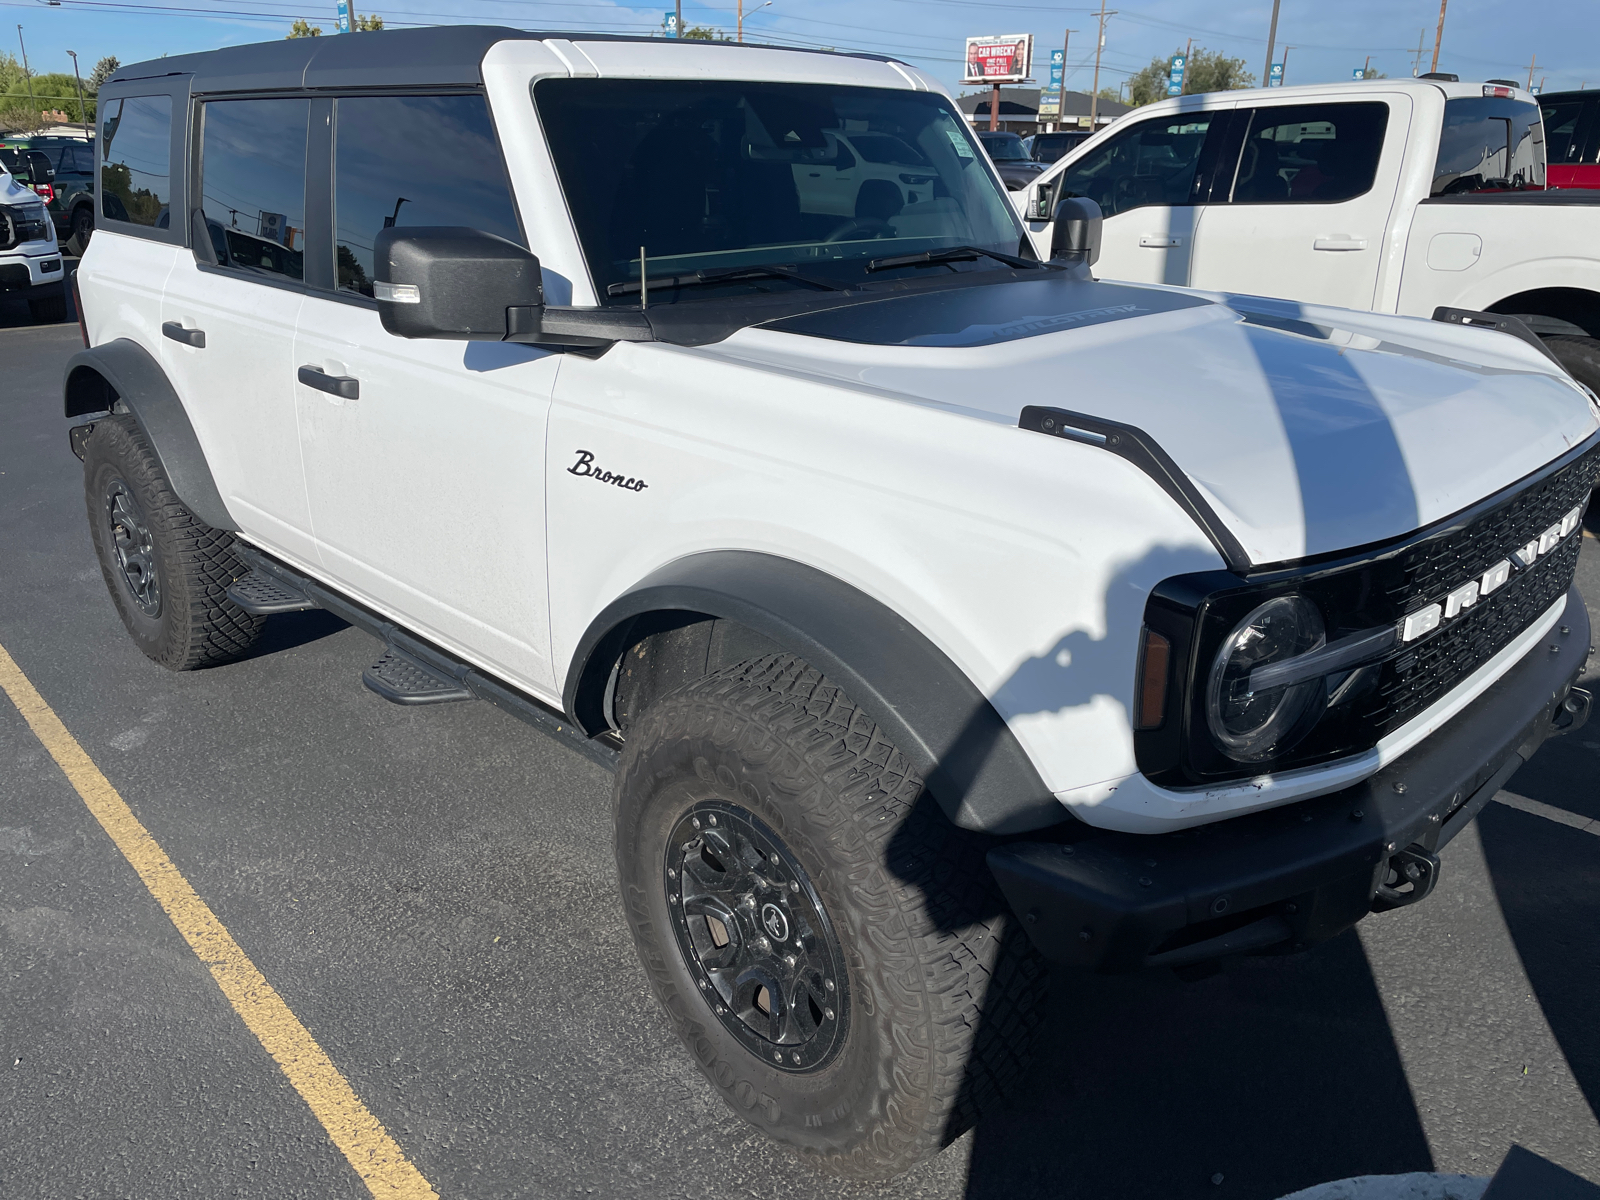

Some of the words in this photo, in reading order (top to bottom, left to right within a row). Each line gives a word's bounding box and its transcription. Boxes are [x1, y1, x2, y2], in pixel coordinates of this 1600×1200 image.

[978, 48, 990, 57] CAR
[991, 46, 1015, 57] WRECK?
[996, 57, 1007, 66] CALL
[984, 66, 999, 75] THAT'S
[1000, 66, 1008, 74] ALL
[991, 305, 1150, 336] WILDTRAK
[566, 449, 649, 492] Bronco
[1402, 506, 1581, 642] BRONCO
